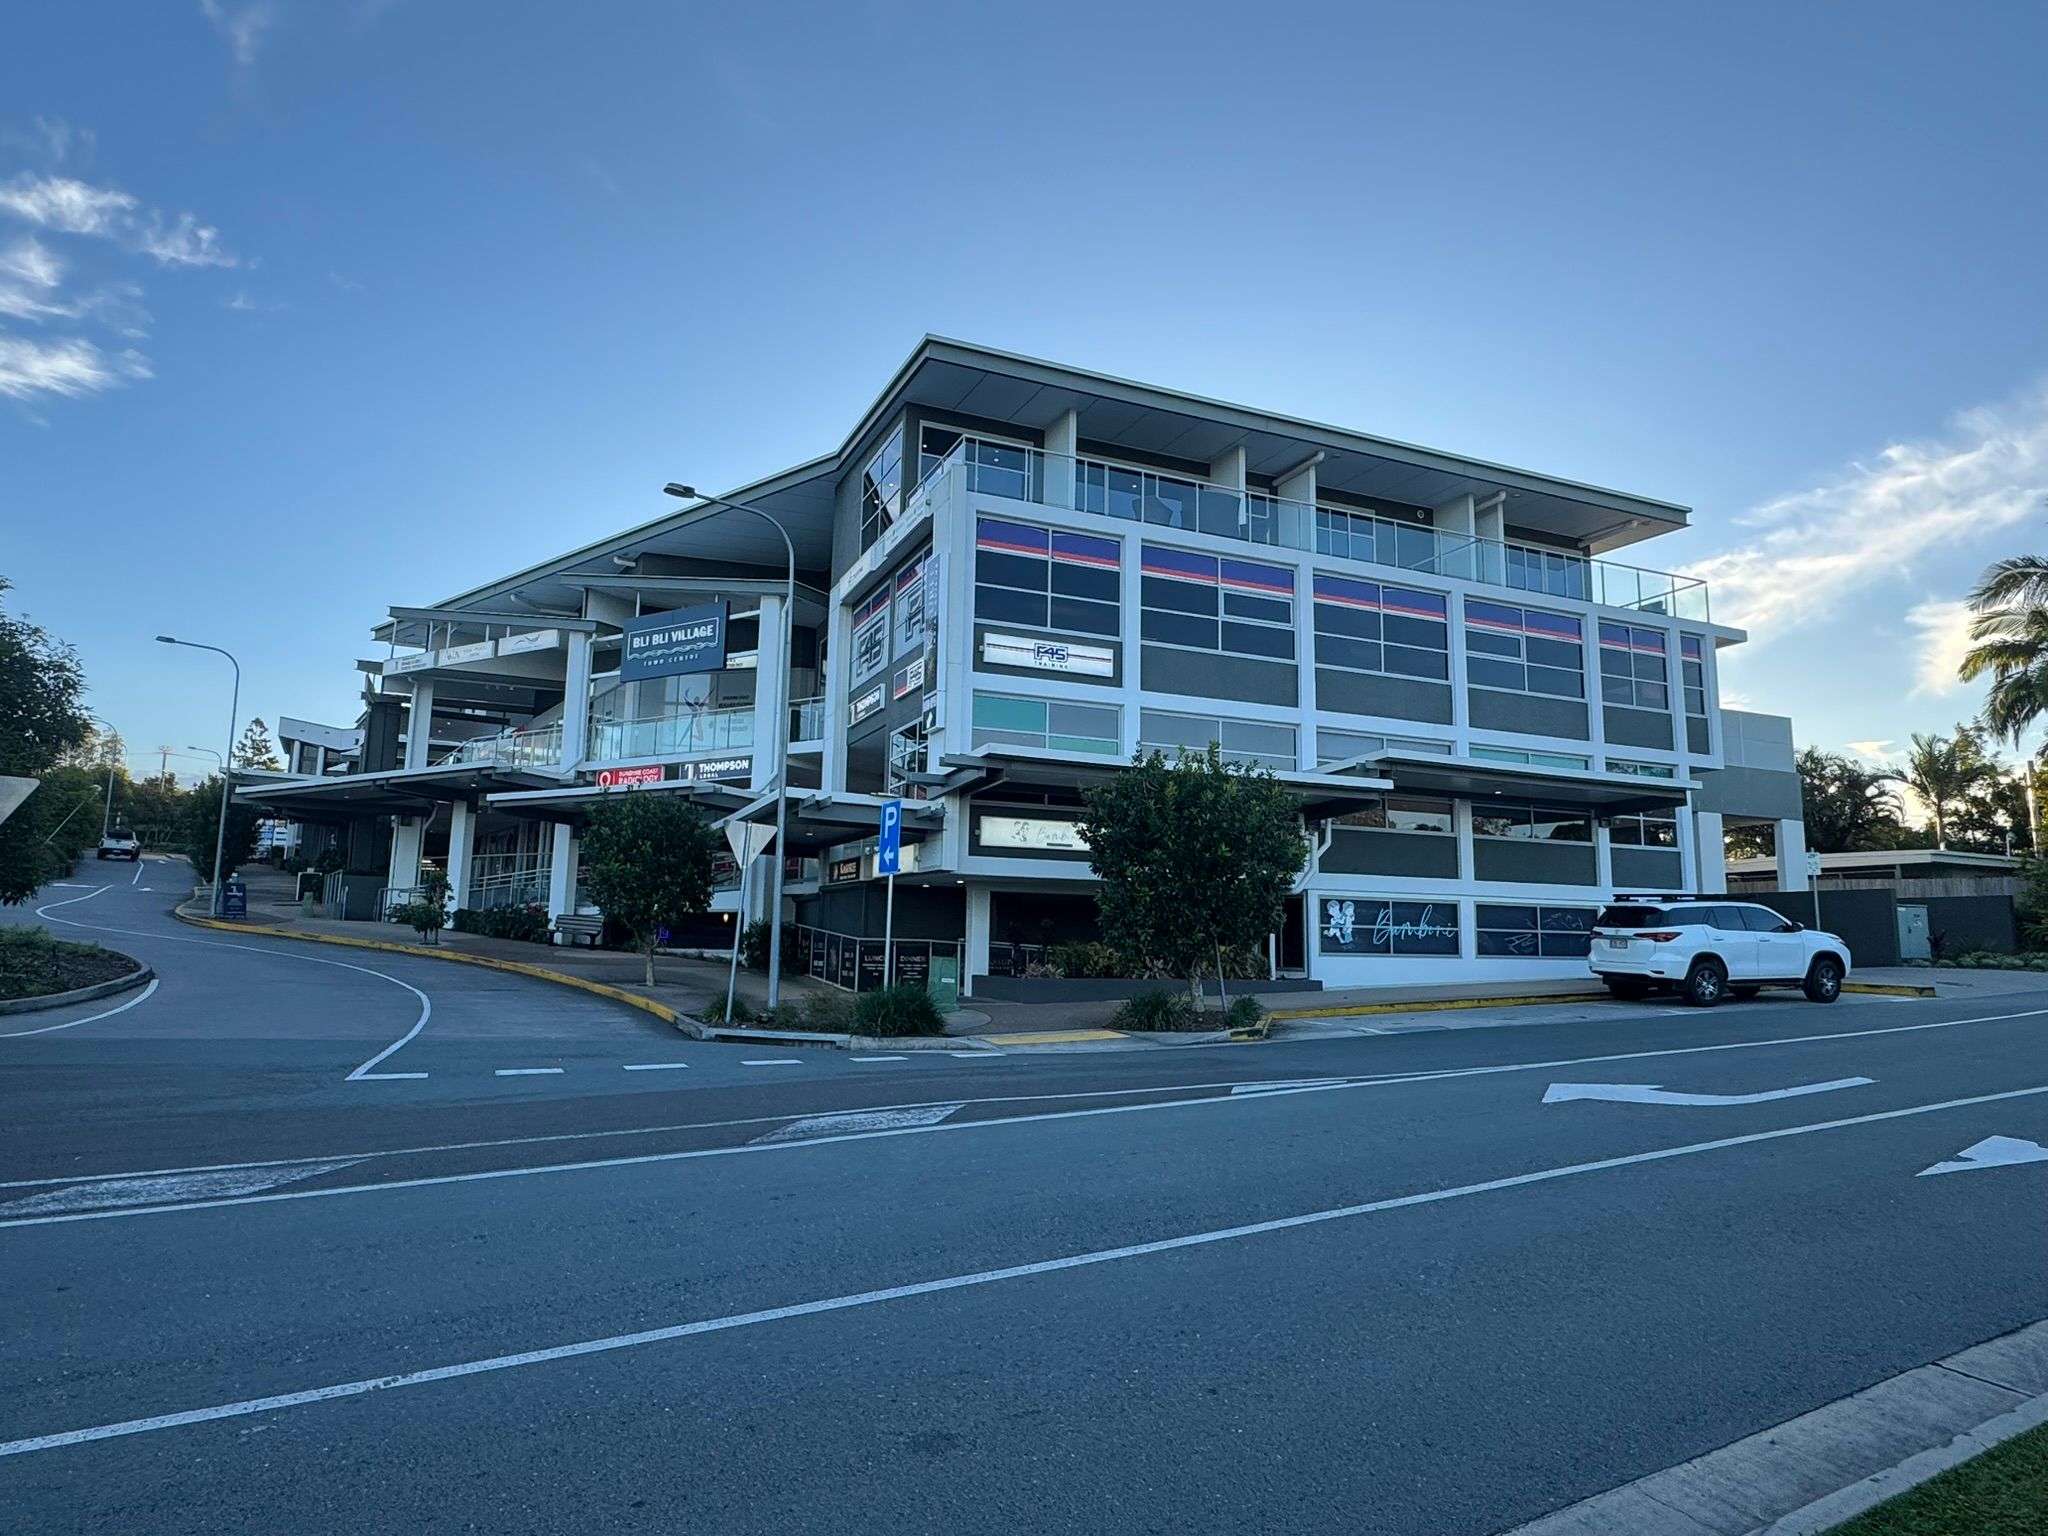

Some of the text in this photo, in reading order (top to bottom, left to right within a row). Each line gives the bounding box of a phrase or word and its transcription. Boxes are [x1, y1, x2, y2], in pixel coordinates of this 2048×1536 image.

[633, 624, 714, 648] BLI BLI VILLAGE
[644, 653, 699, 667] TOWN CENTRE
[1036, 645, 1067, 661] F45
[1034, 660, 1069, 670] TRAINING
[642, 767, 659, 776] COAST
[699, 759, 749, 773] THOMPSON
[700, 772, 718, 780] LEGAL
[884, 806, 898, 839] P
[1373, 904, 1456, 945] Bambini
[900, 955, 927, 963] DINNER
